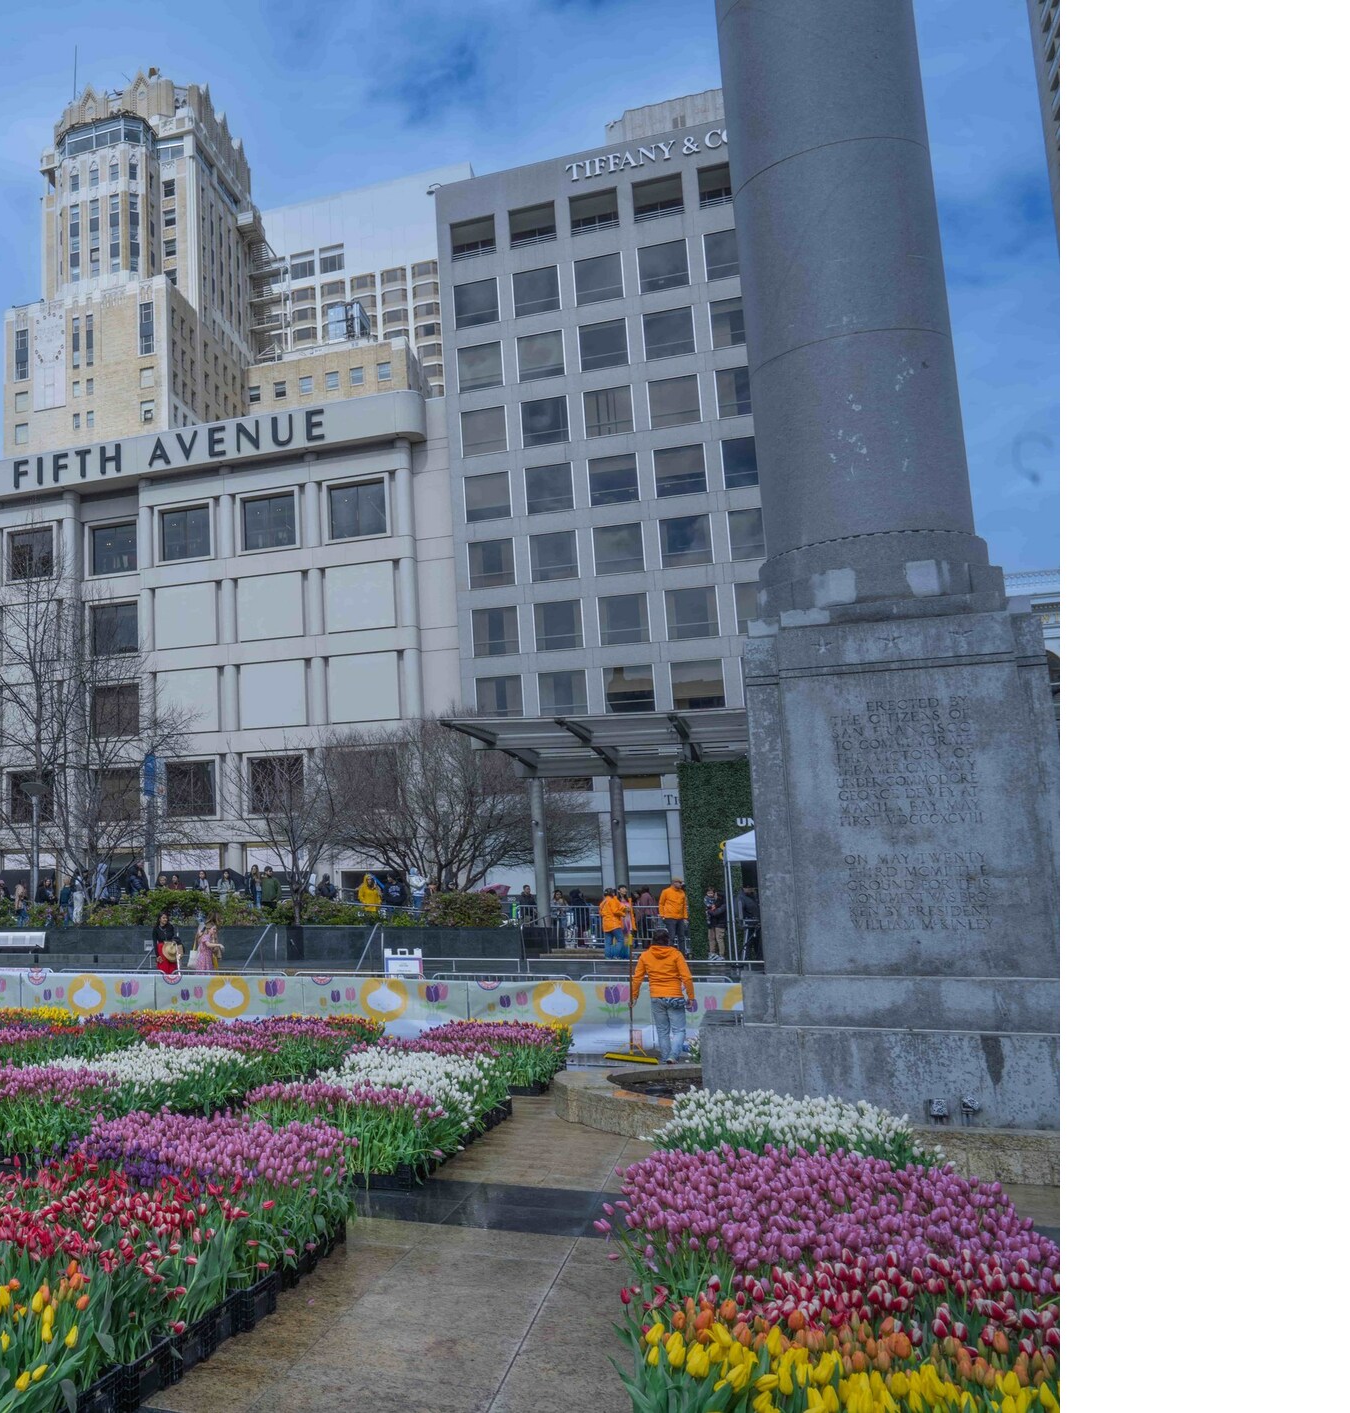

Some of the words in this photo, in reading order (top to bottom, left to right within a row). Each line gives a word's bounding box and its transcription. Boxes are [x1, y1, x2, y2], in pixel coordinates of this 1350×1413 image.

[565, 139, 676, 182] TIFFANY
[682, 136, 700, 156] &
[13, 443, 122, 489] FIFTH
[148, 408, 326, 467] AVENUE
[867, 698, 939, 712] ERECTED
[950, 696, 968, 707] BY
[832, 714, 861, 727] THE
[869, 710, 940, 725] CITIZENS
[949, 708, 969, 721] OF
[833, 728, 864, 739] SAN
[835, 741, 853, 752] TO
[954, 747, 973, 759] OF
[906, 786, 955, 799] DEWEY
[962, 785, 977, 797] AT
[844, 854, 867, 866] ON
[878, 853, 910, 865] MAY
[917, 851, 987, 865] TWENTY
[847, 880, 914, 892] GROUND
[850, 905, 878, 918] KEN
[908, 904, 991, 917] PRESIDENT
[852, 918, 915, 931] WILLIAM
